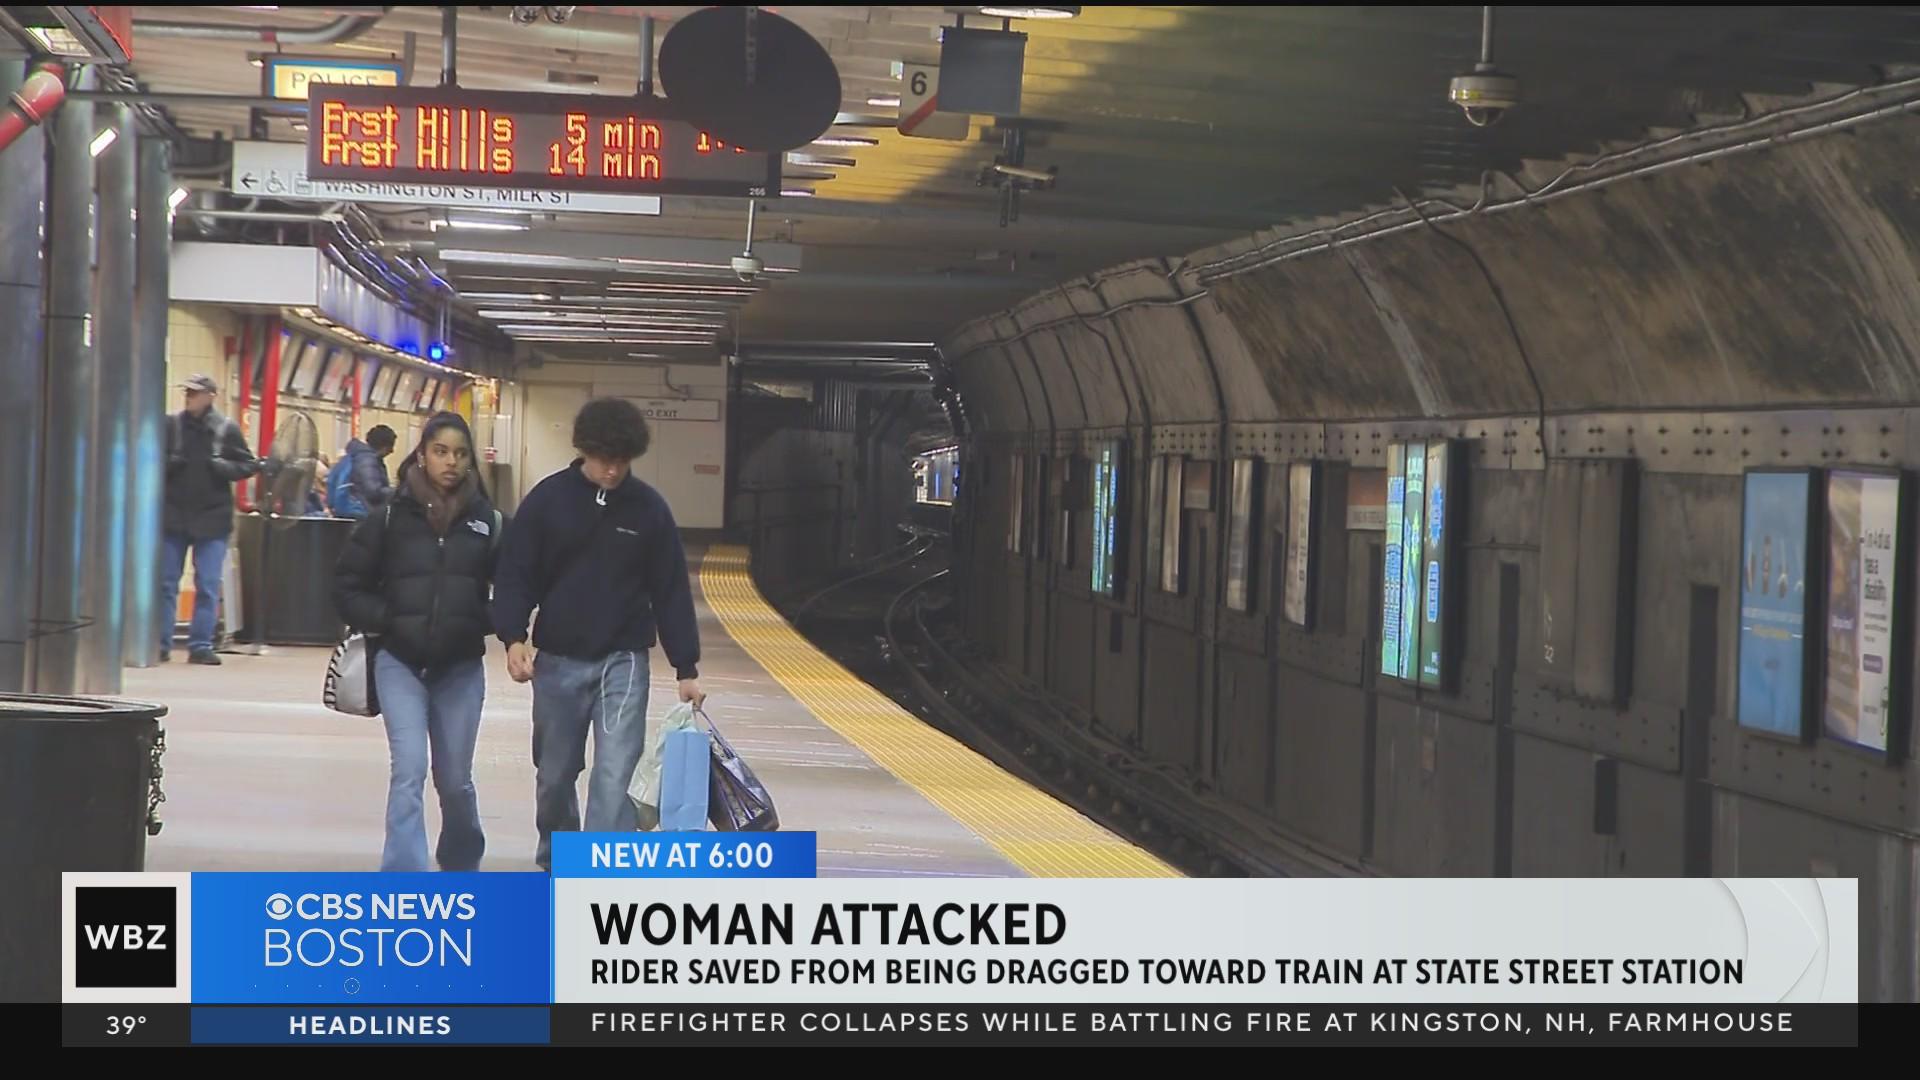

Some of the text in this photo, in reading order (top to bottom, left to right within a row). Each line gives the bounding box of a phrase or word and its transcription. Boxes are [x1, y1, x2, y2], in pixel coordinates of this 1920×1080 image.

[911, 71, 927, 96] 6
[322, 101, 399, 136] Frst
[416, 105, 513, 142] Hills
[566, 112, 587, 145] 5
[603, 116, 661, 149] min
[322, 131, 661, 179] Frst Hills 14 min
[497, 188, 542, 202] MILK
[656, 409, 678, 418] EXIT
